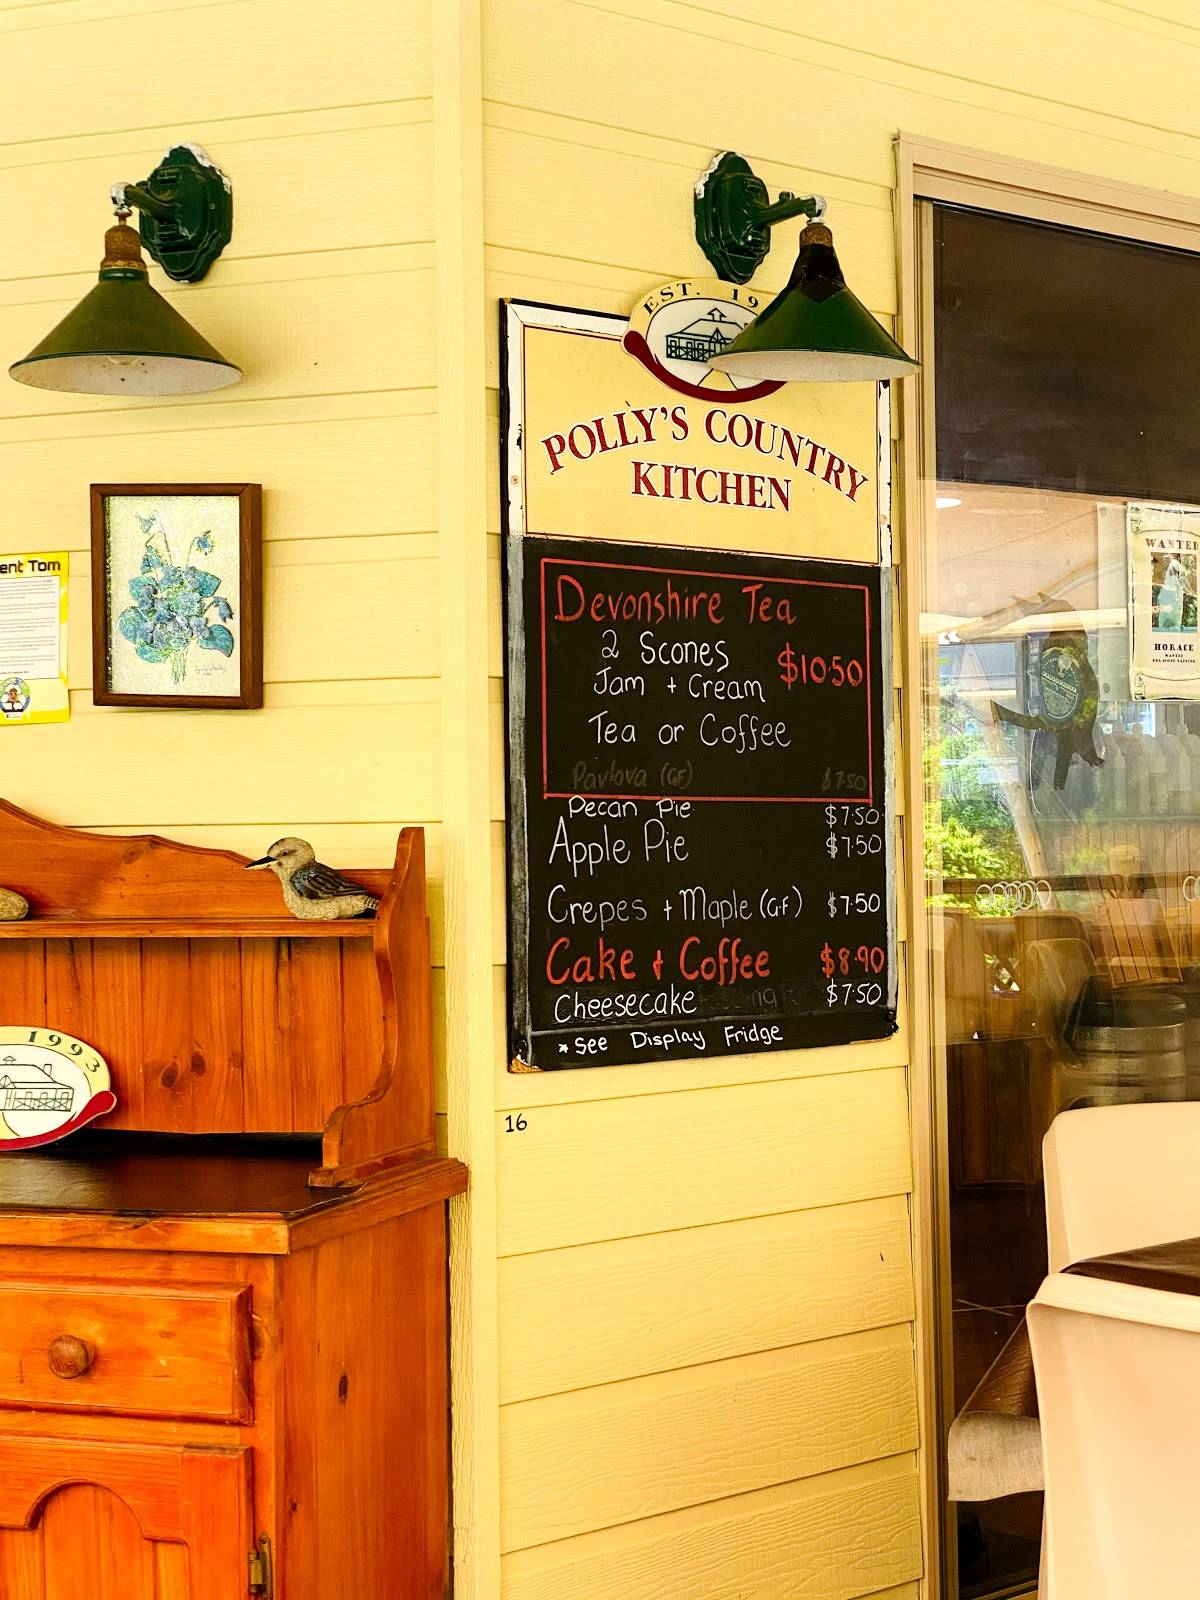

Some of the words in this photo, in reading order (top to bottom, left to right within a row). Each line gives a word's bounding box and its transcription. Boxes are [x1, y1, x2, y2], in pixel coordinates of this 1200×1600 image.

[643, 282, 701, 316] EST.
[541, 406, 690, 475] POLLY'S
[705, 409, 869, 503] COUNTRY
[631, 461, 792, 512] KITCHEN
[1145, 538, 1199, 551] WANTED
[28, 560, 61, 572] Tom
[553, 574, 725, 625] Devonshire
[742, 583, 797, 624] Tea
[601, 629, 619, 659] 2
[640, 631, 729, 672] Scones
[1154, 643, 1194, 652] HORACE
[593, 666, 645, 697] Jam
[688, 673, 766, 702] Cream
[588, 710, 636, 744] Tea
[658, 722, 685, 743] or
[700, 713, 792, 753] Coffee
[571, 759, 647, 791] Pavlova
[568, 795, 638, 818] Pecan
[656, 798, 691, 818] Pie
[548, 816, 631, 877] Apple
[644, 818, 689, 863] Pie
[547, 884, 648, 930] Crepes
[678, 886, 753, 928] Maple
[545, 936, 637, 985] Cake
[679, 936, 771, 986] Coffee
[554, 983, 698, 1023] Cheesecake
[28, 1030, 101, 1073] 1993
[631, 1029, 706, 1051] Display
[724, 1023, 784, 1047] Fridge
[505, 1113, 528, 1133] 16
